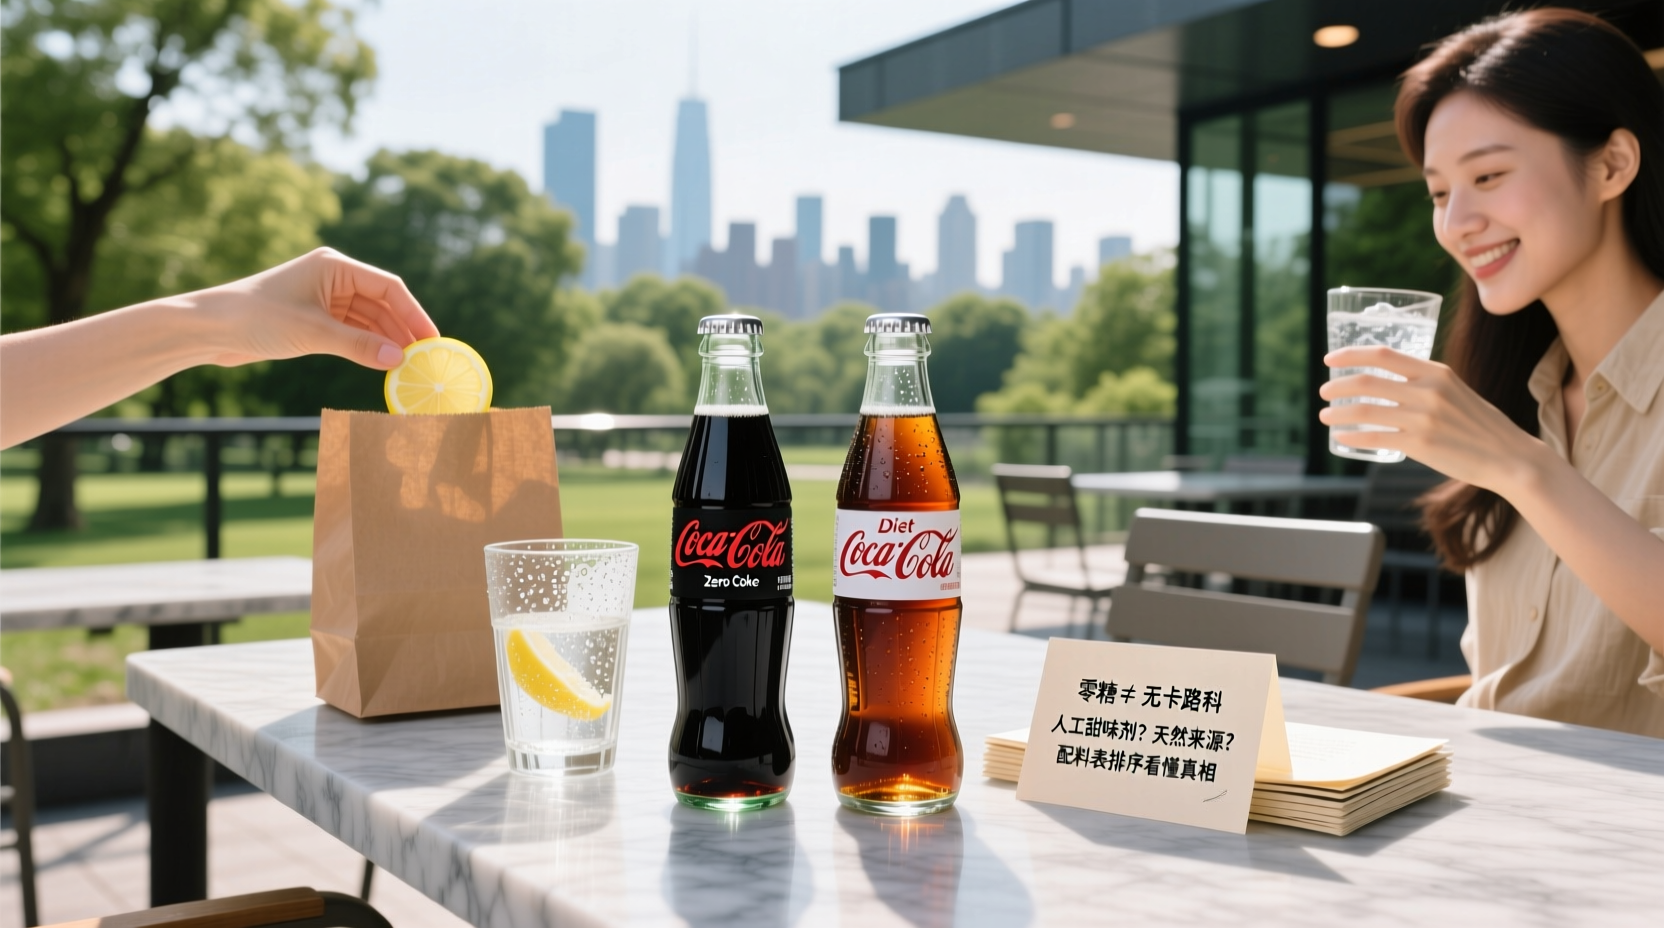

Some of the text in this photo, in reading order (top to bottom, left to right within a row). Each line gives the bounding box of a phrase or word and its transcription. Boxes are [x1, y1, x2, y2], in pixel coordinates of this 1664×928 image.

[878, 518, 915, 533] Diet
[675, 518, 788, 568] Coca-Cola
[840, 527, 958, 579] Coca-Cola
[704, 574, 760, 587] Zero Coke
